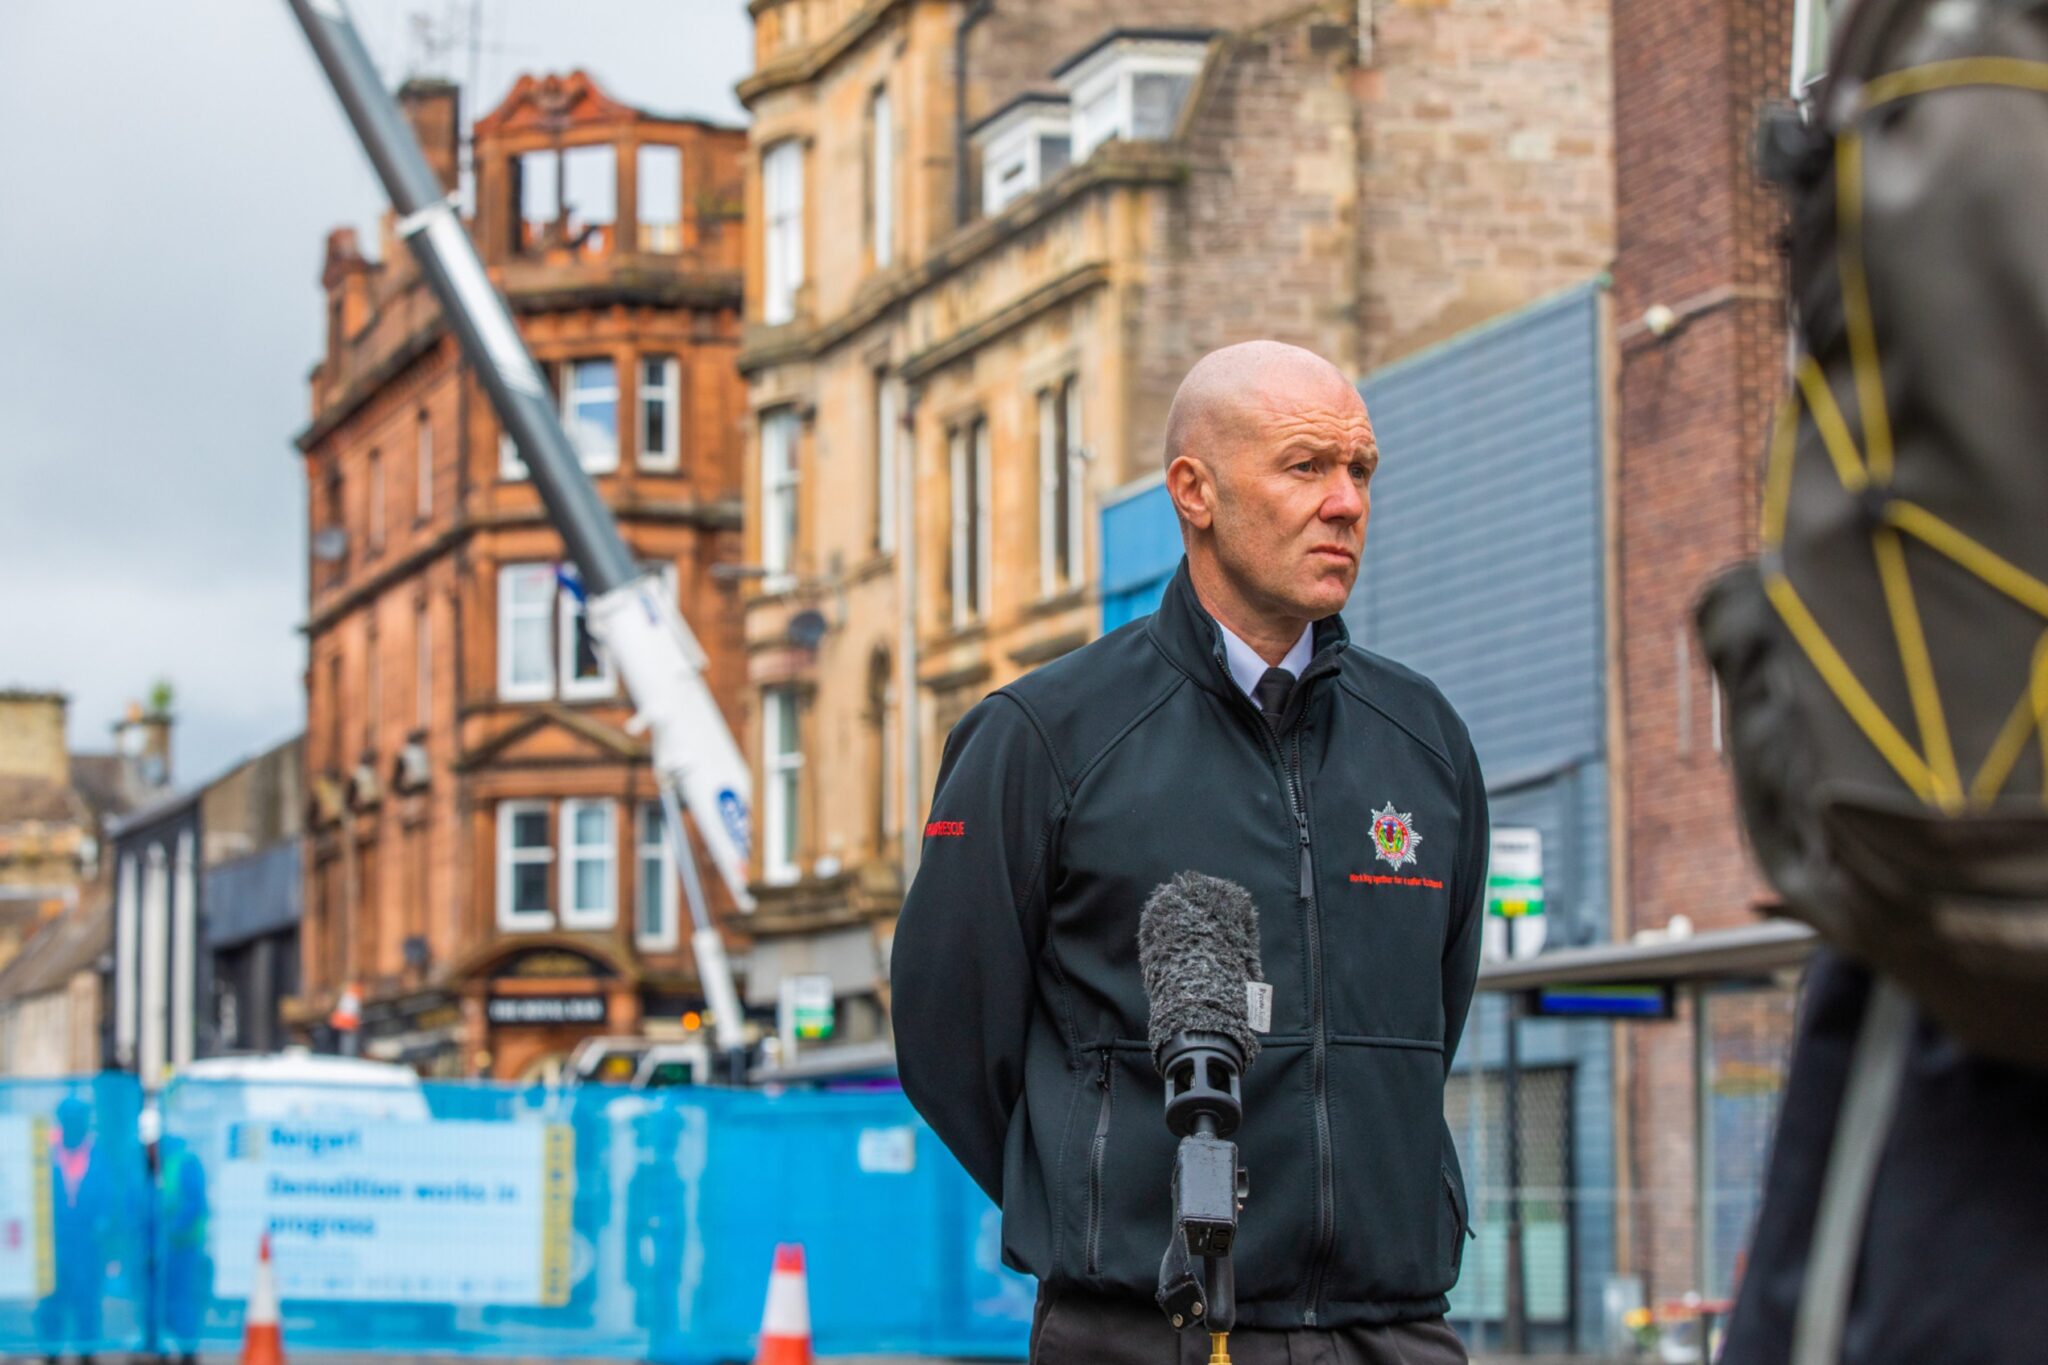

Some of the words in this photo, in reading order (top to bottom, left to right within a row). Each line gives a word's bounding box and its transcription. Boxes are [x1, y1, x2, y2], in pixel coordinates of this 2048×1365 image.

[270, 1173, 401, 1199] Demolition
[415, 1177, 486, 1201] works
[496, 1179, 517, 1201] in
[269, 1214, 376, 1238] progress
